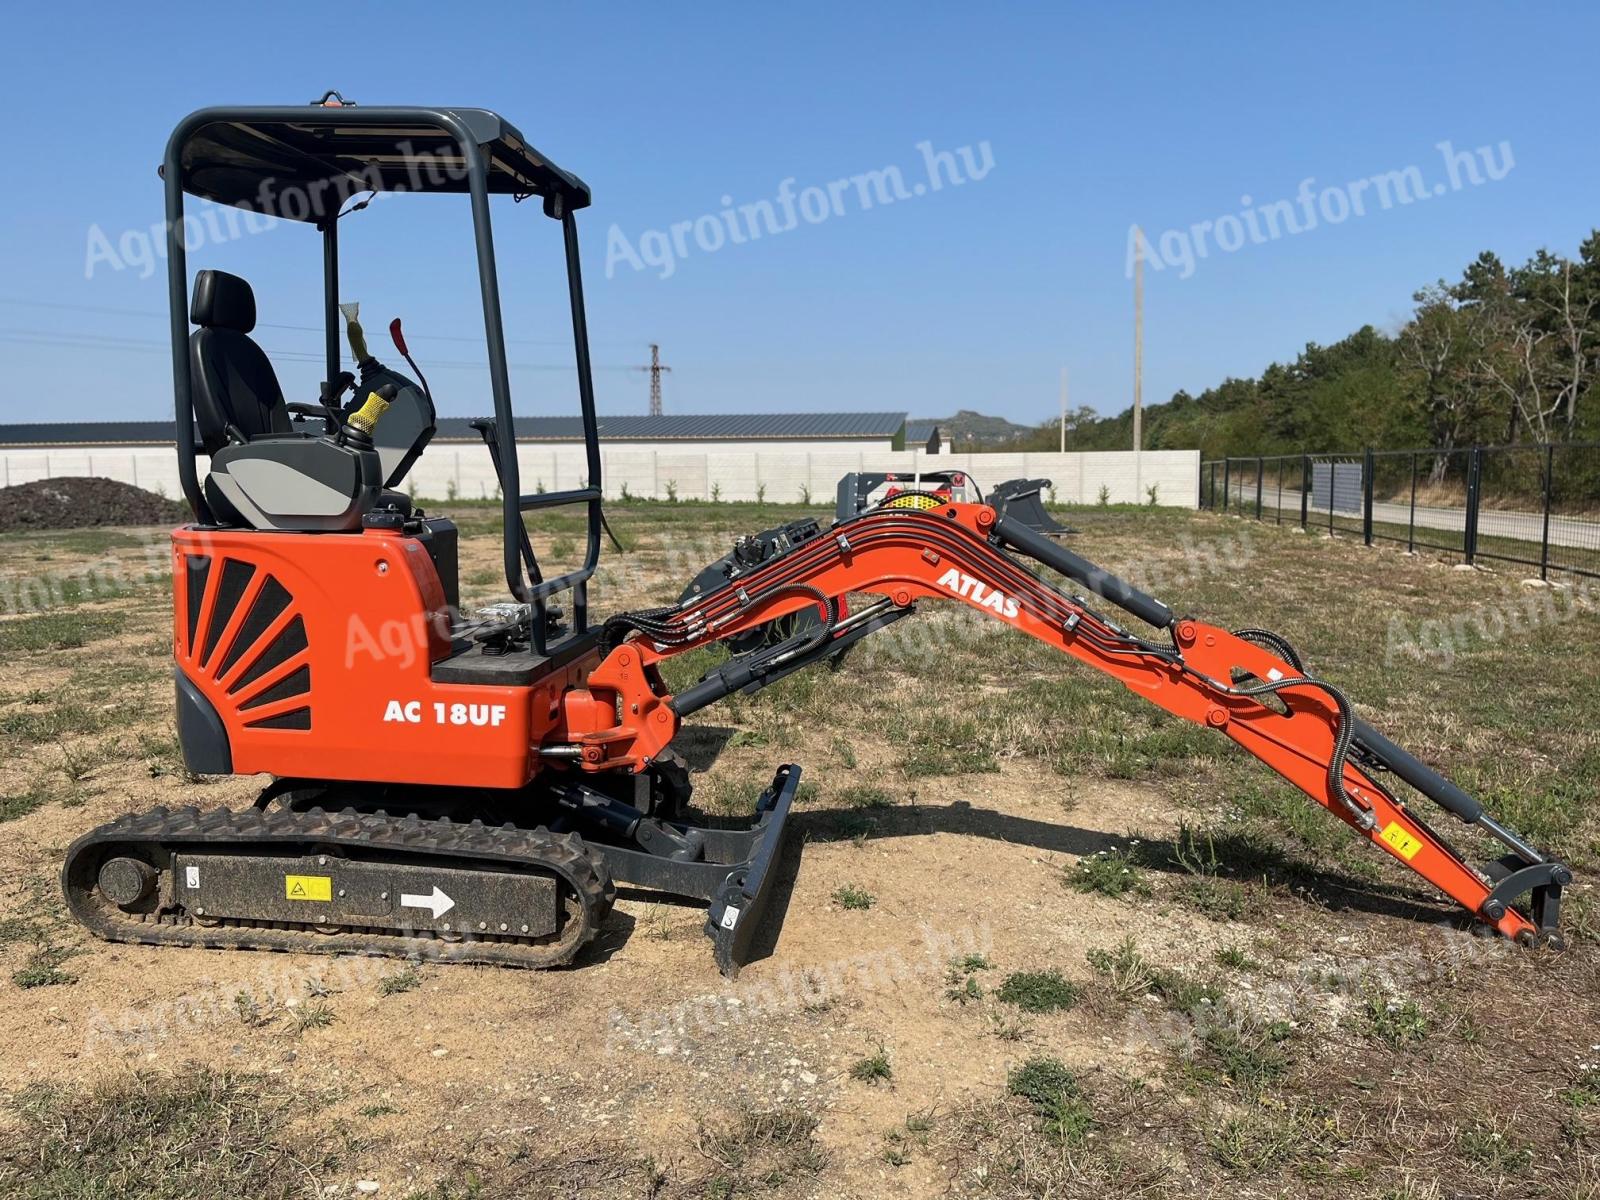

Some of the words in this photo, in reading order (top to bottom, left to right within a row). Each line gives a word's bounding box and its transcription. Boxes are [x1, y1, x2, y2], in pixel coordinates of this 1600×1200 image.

[937, 568, 1021, 618] ATLAS
[383, 700, 421, 723] AC
[433, 703, 506, 726] 18UF
